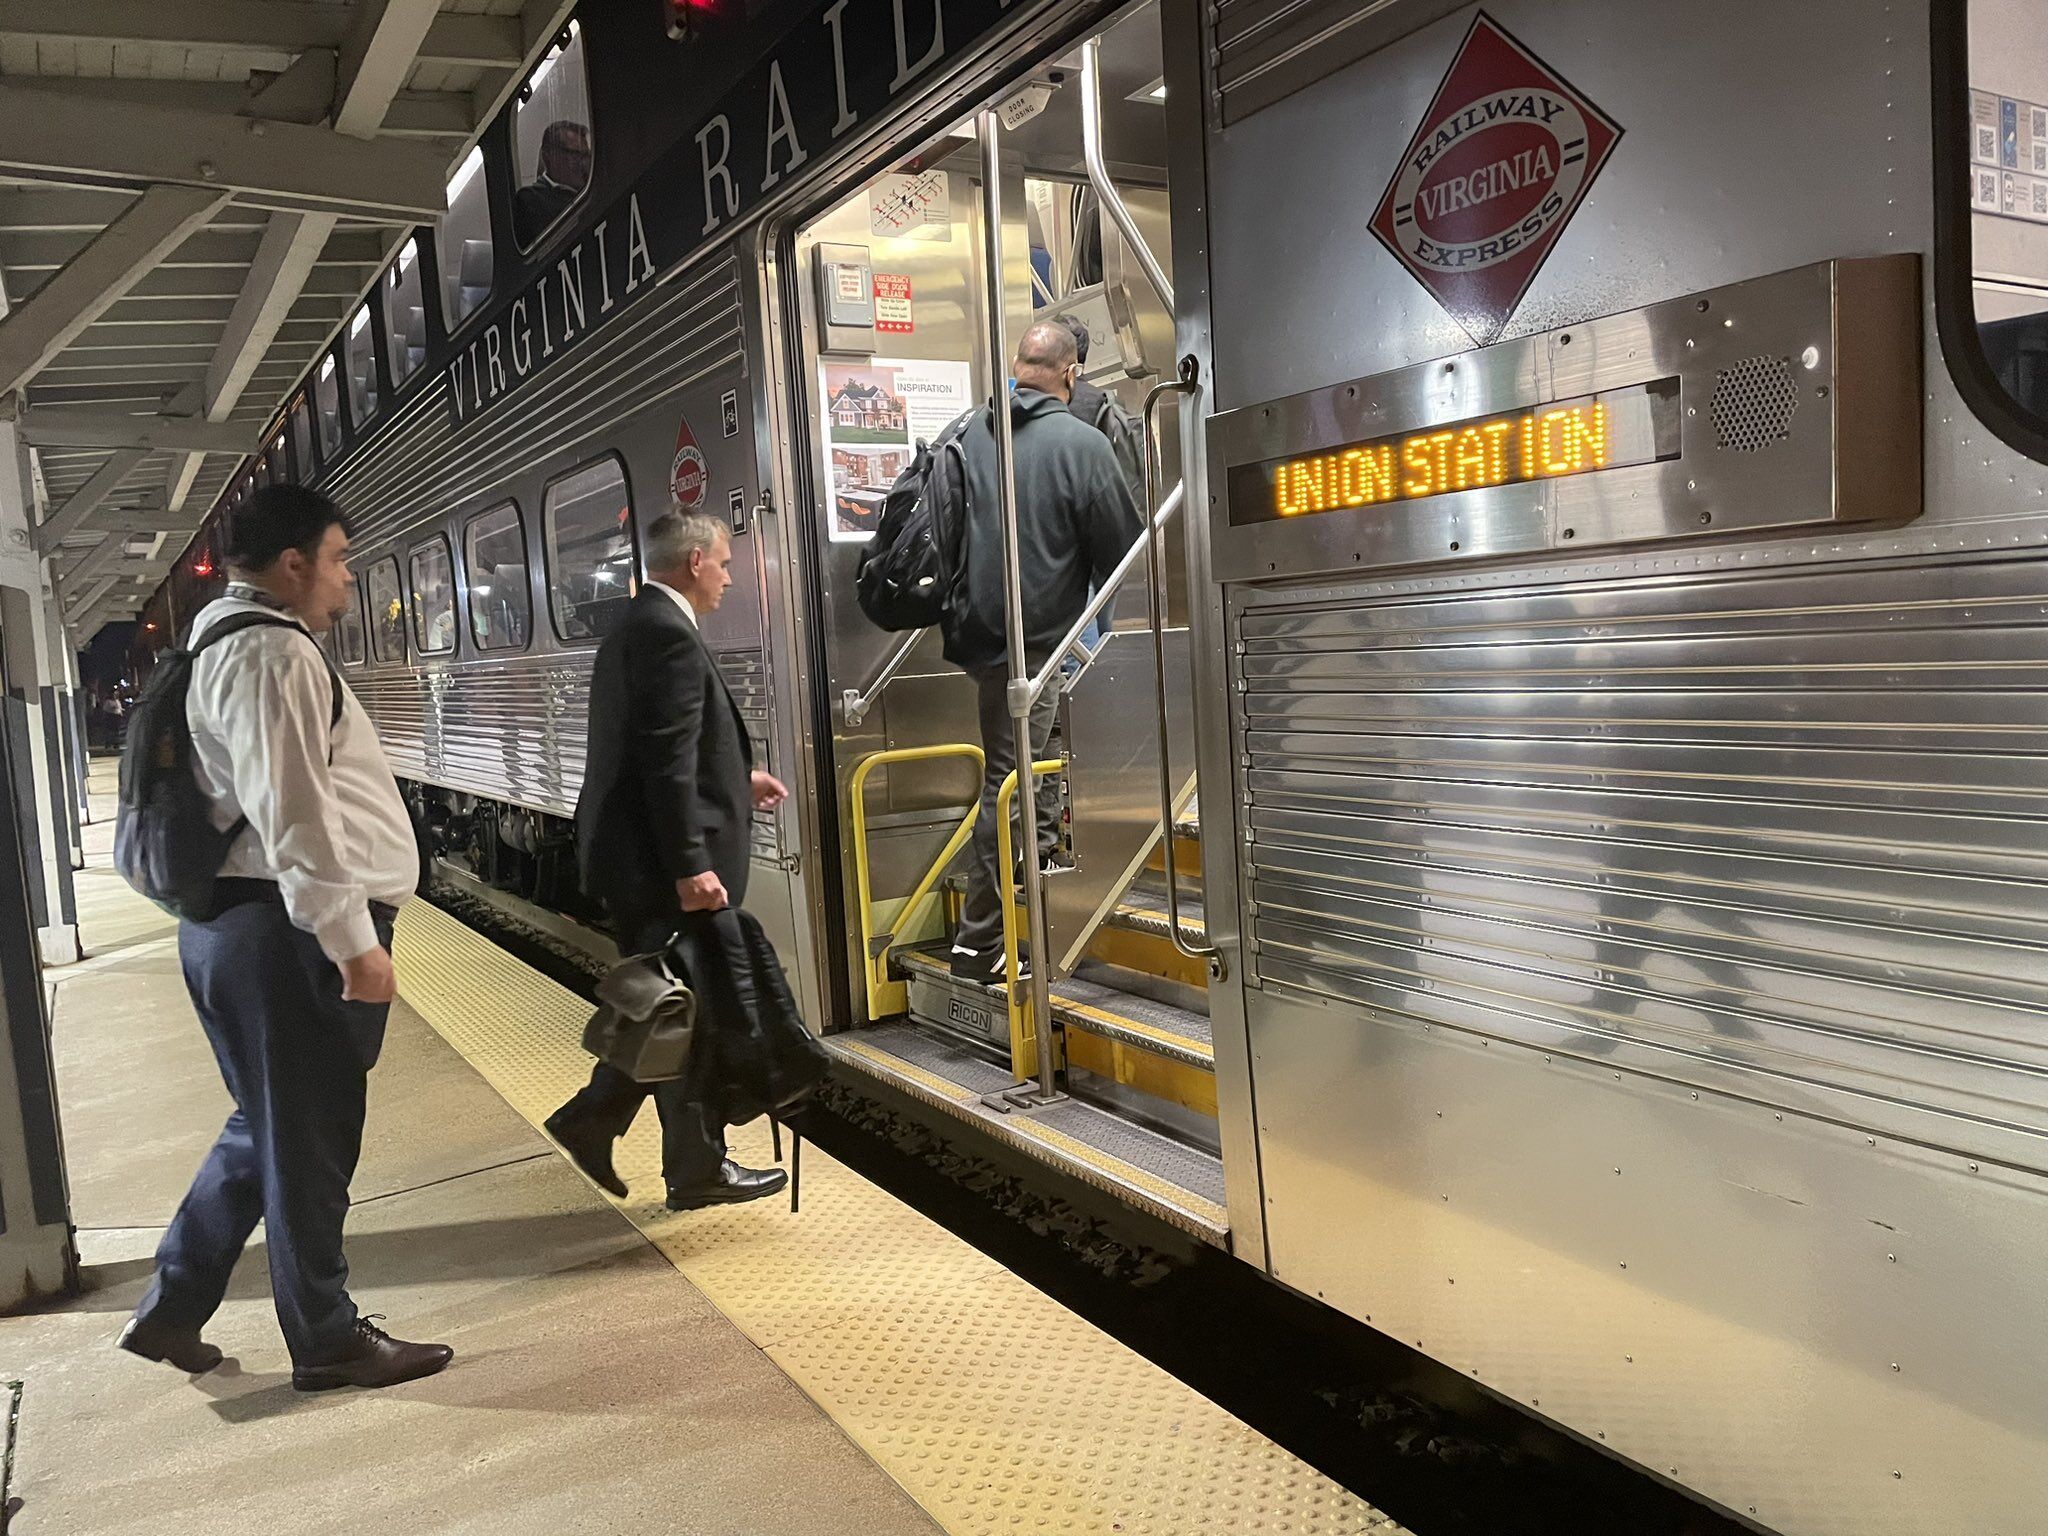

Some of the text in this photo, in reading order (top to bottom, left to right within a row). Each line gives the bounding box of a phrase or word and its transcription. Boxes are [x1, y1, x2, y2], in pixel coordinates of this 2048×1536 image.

[1007, 104, 1035, 124] CLOSING
[1008, 98, 1026, 112] DOOR
[1412, 95, 1565, 175] RAILWAY
[1418, 144, 1555, 221] VIRGINIA
[450, 0, 1009, 420] VIRGINIA RAIL
[1413, 191, 1565, 267] EXPRESS
[874, 274, 910, 284] EMERGENCY
[876, 282, 908, 291] SIDE DOOR
[879, 290, 906, 298] RELEASE
[896, 382, 953, 394] INSPIRATION
[1276, 402, 1607, 516] UNION STATION
[951, 1003, 988, 1028] RICON
